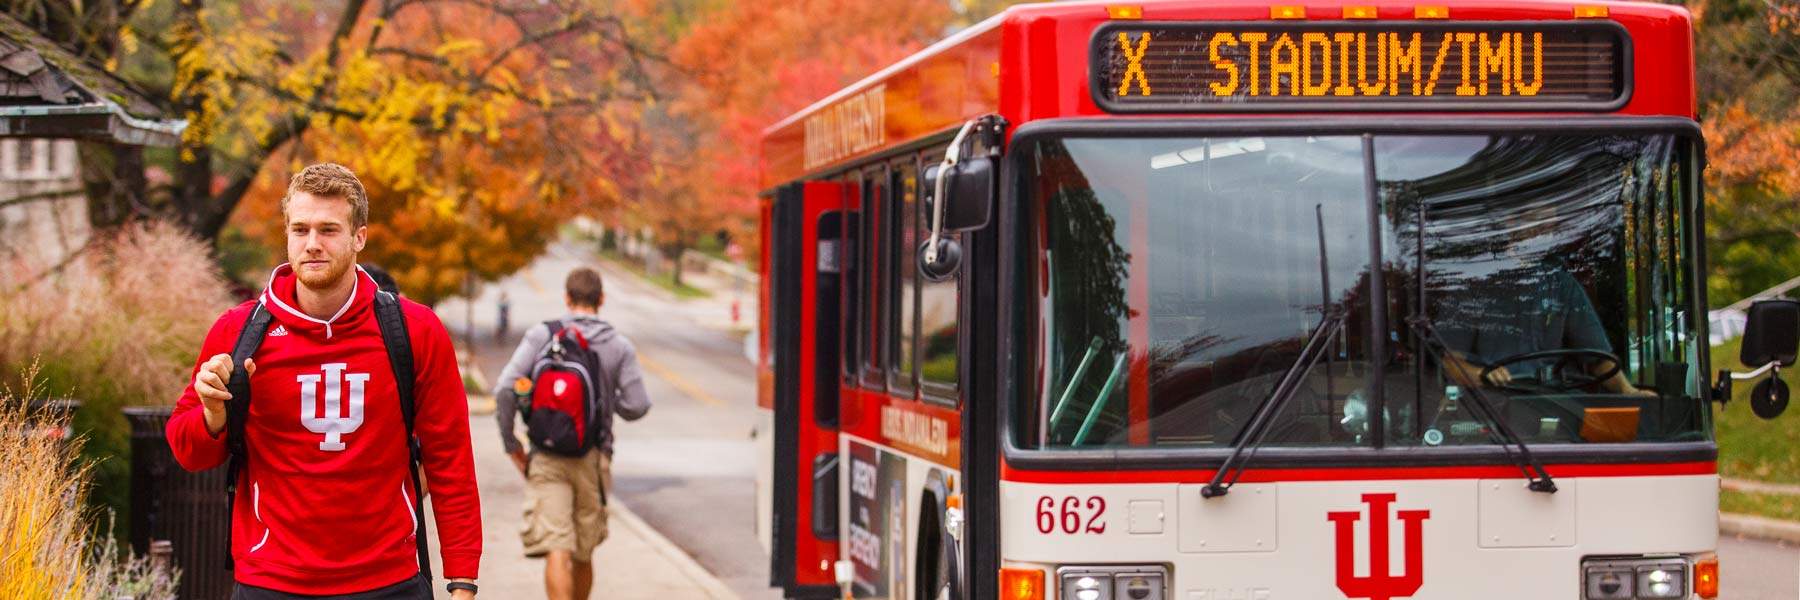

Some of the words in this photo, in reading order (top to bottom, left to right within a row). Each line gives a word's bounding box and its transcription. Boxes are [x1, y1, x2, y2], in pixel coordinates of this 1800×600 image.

[1118, 32, 1151, 96] X
[1209, 32, 1543, 96] STADIUM/IMU
[1036, 496, 1107, 534] 662
